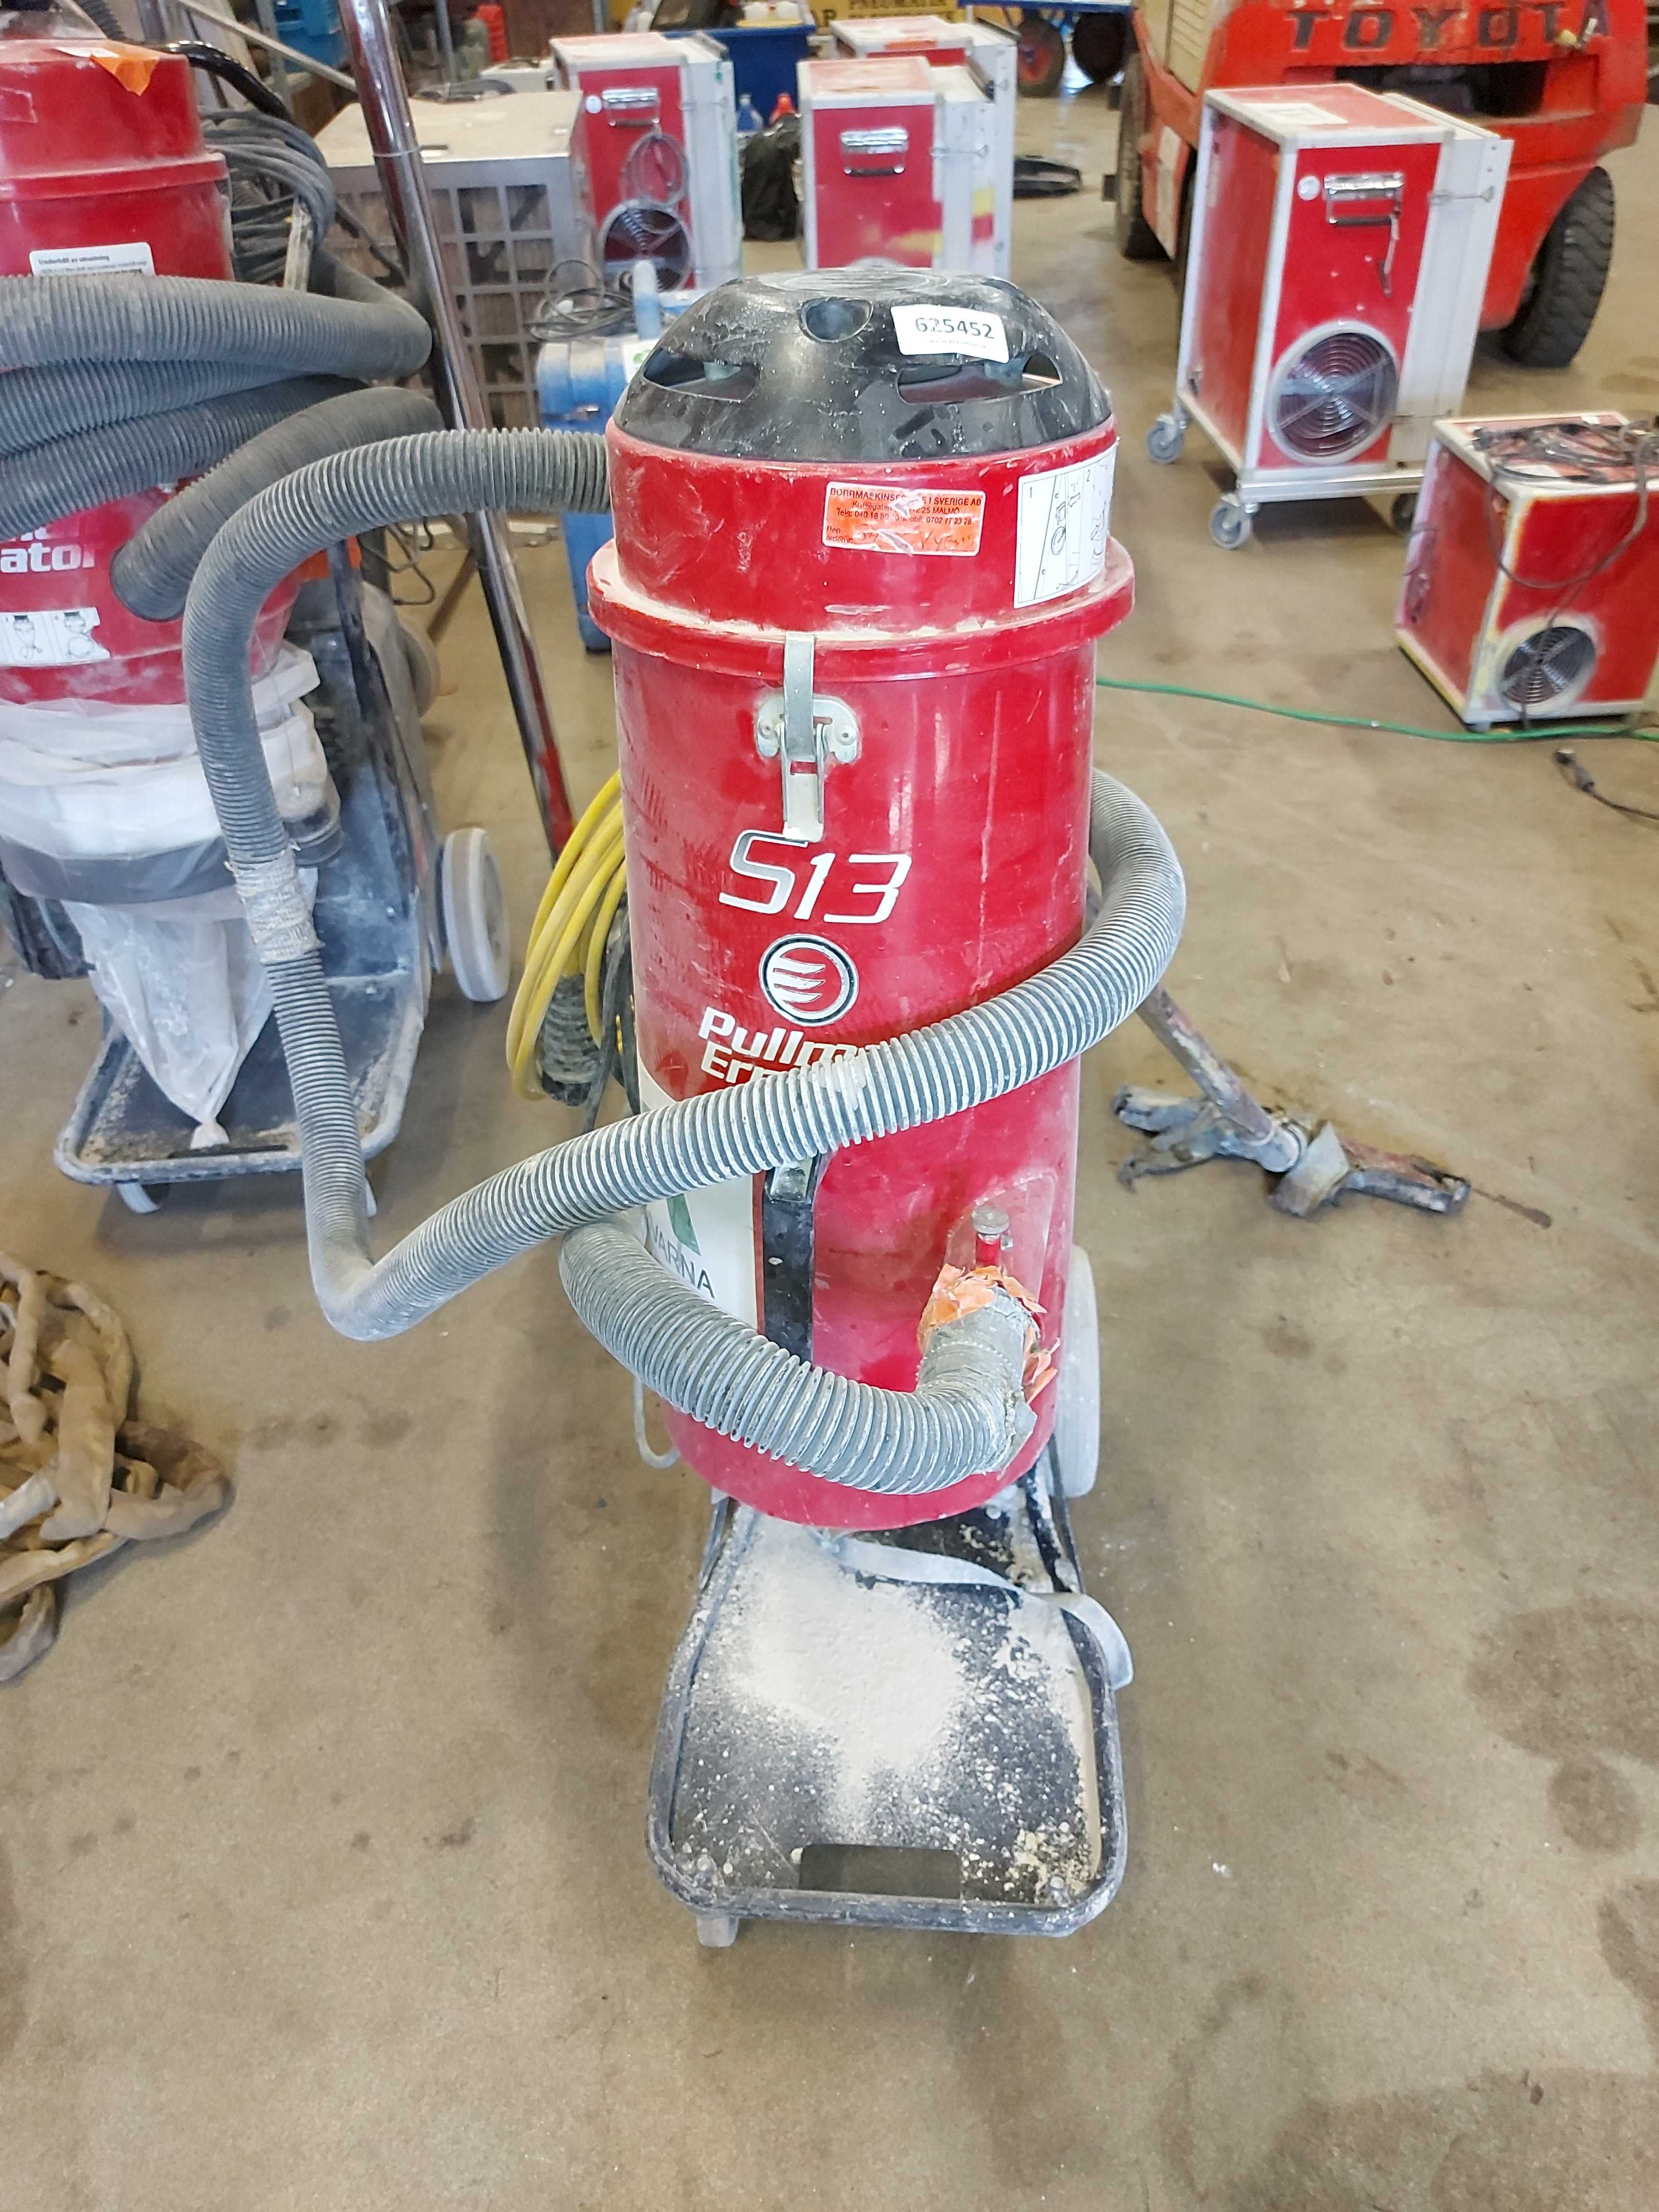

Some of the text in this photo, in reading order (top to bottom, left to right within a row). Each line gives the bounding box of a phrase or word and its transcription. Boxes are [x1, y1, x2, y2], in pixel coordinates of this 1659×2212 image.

[1286, 0, 1610, 49] TOYOTA
[915, 317, 995, 339] 625452
[934, 497, 969, 506] SVERIGE
[970, 498, 981, 506] AB
[719, 829, 912, 924] S13
[698, 1006, 880, 1067] Pullm
